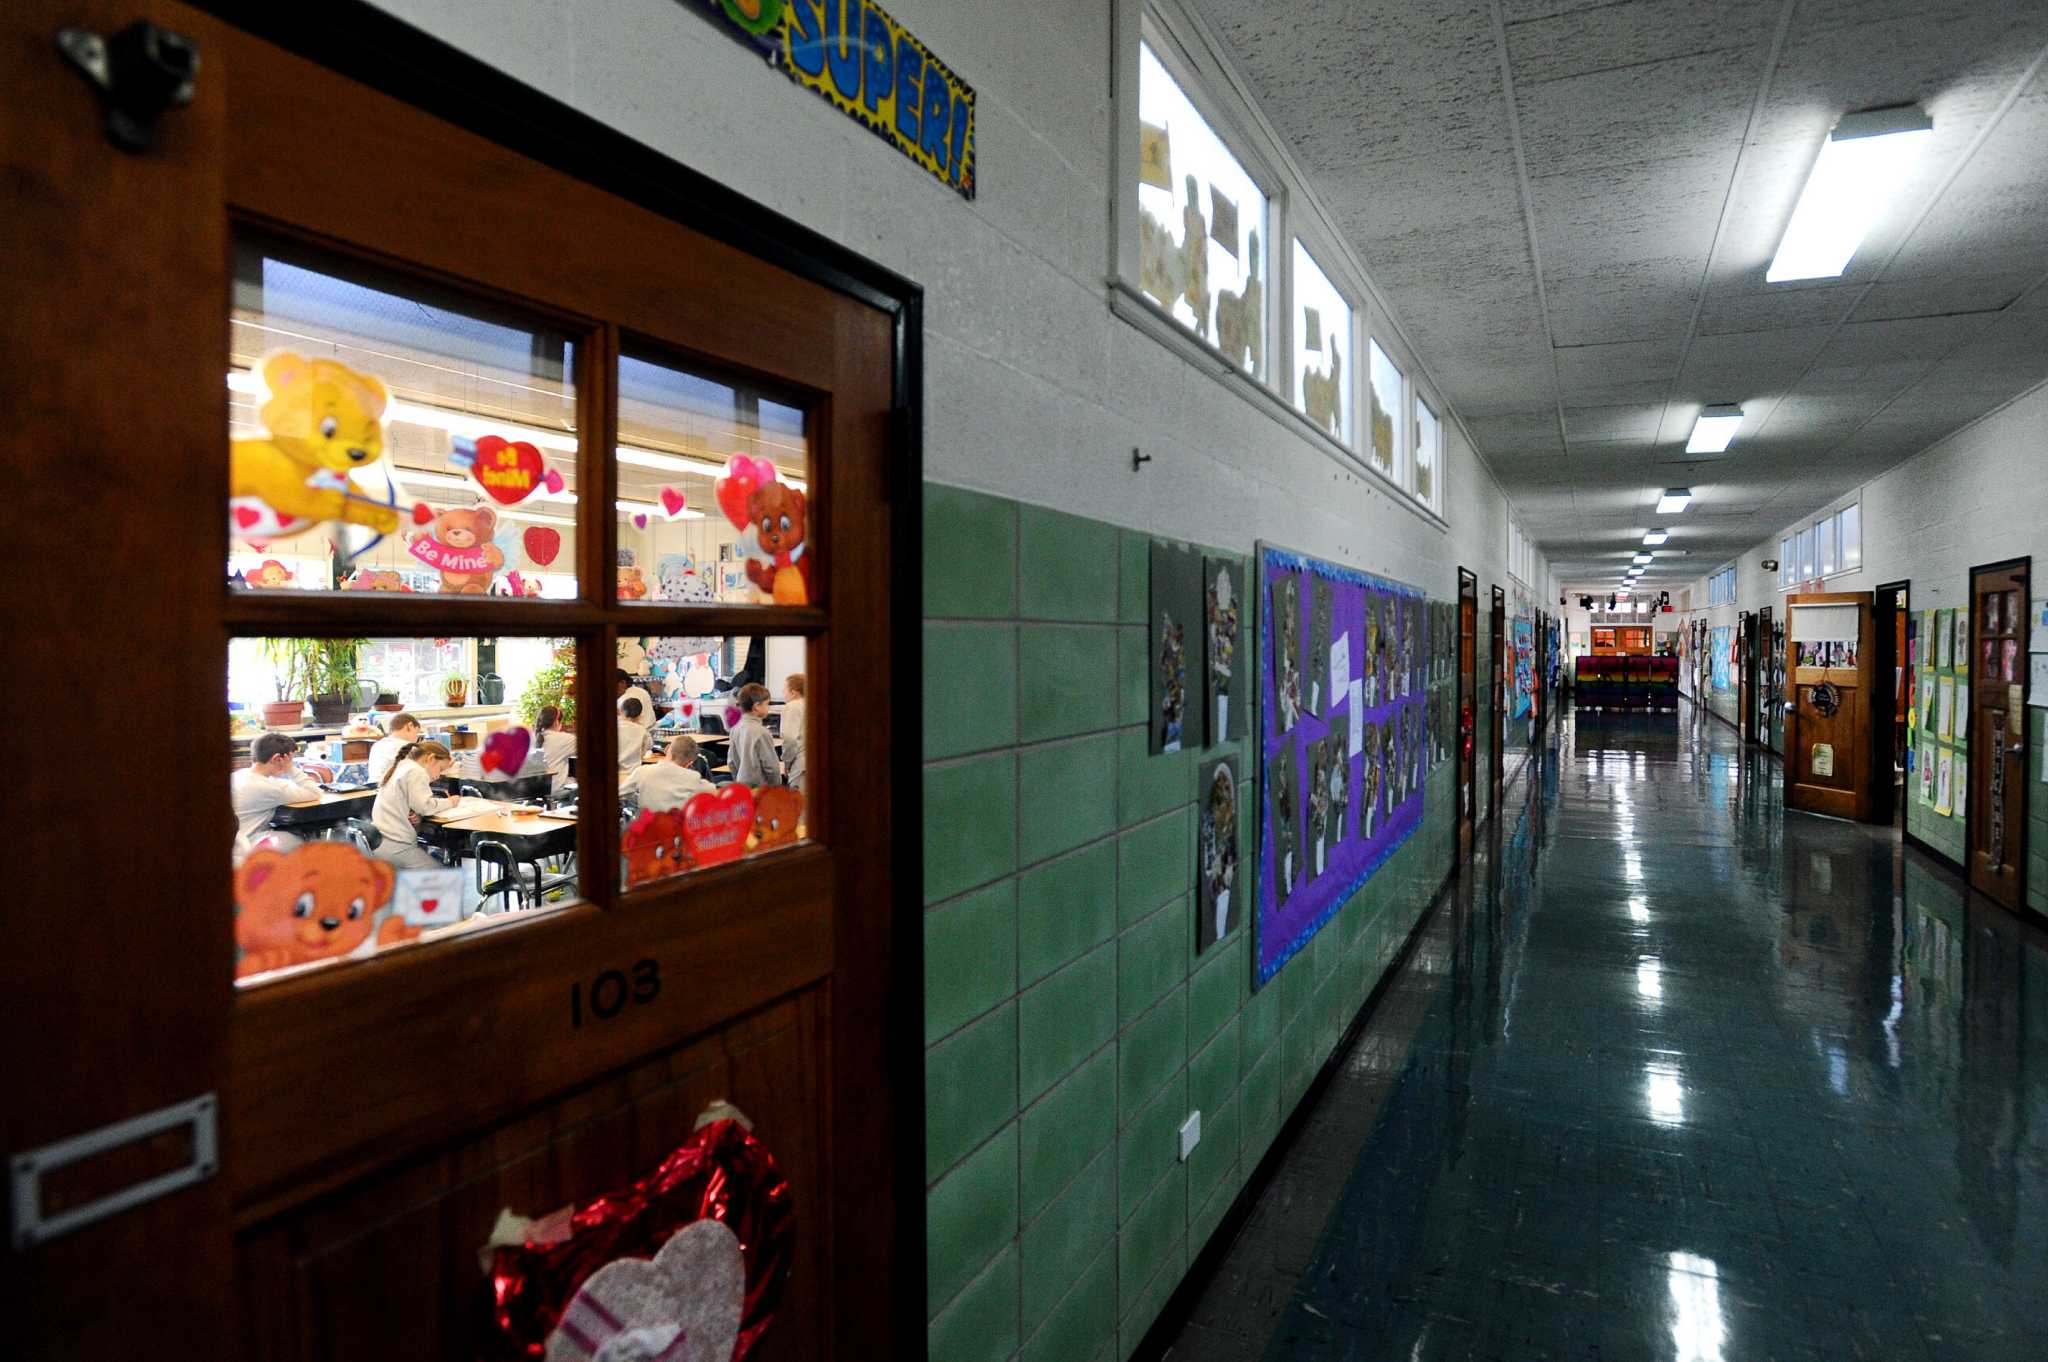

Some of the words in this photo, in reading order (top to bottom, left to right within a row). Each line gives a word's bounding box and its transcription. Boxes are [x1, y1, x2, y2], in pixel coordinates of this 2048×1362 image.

[789, 0, 969, 184] SUPER!
[415, 540, 439, 561] Be
[440, 552, 488, 570] Mine
[571, 959, 661, 1030] 103
